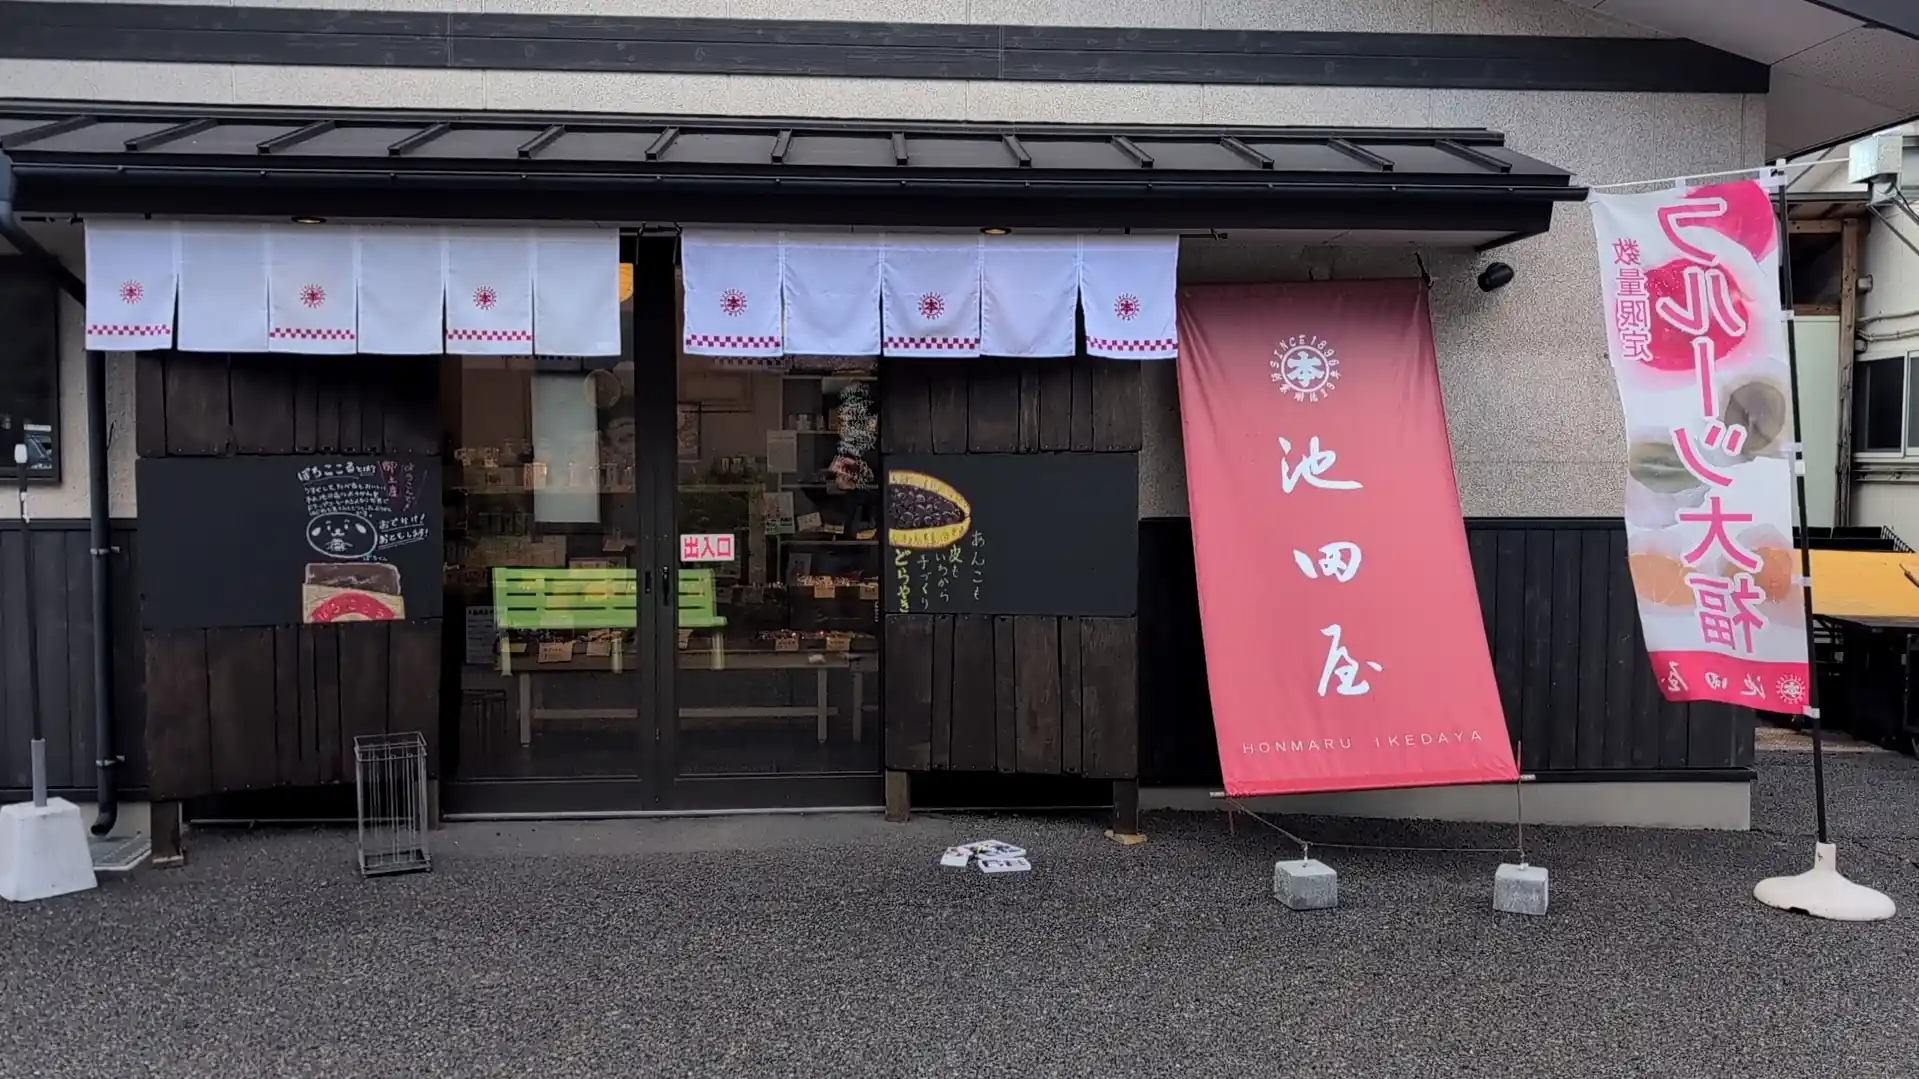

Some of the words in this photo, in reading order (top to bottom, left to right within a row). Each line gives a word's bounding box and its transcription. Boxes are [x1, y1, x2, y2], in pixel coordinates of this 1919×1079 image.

[684, 536, 731, 558] 出入口
[1278, 435, 1383, 697] 池田屋
[894, 548, 912, 613] どらやき
[1242, 737, 1352, 754] HONMARU
[1374, 729, 1483, 748] IKEDAYA
